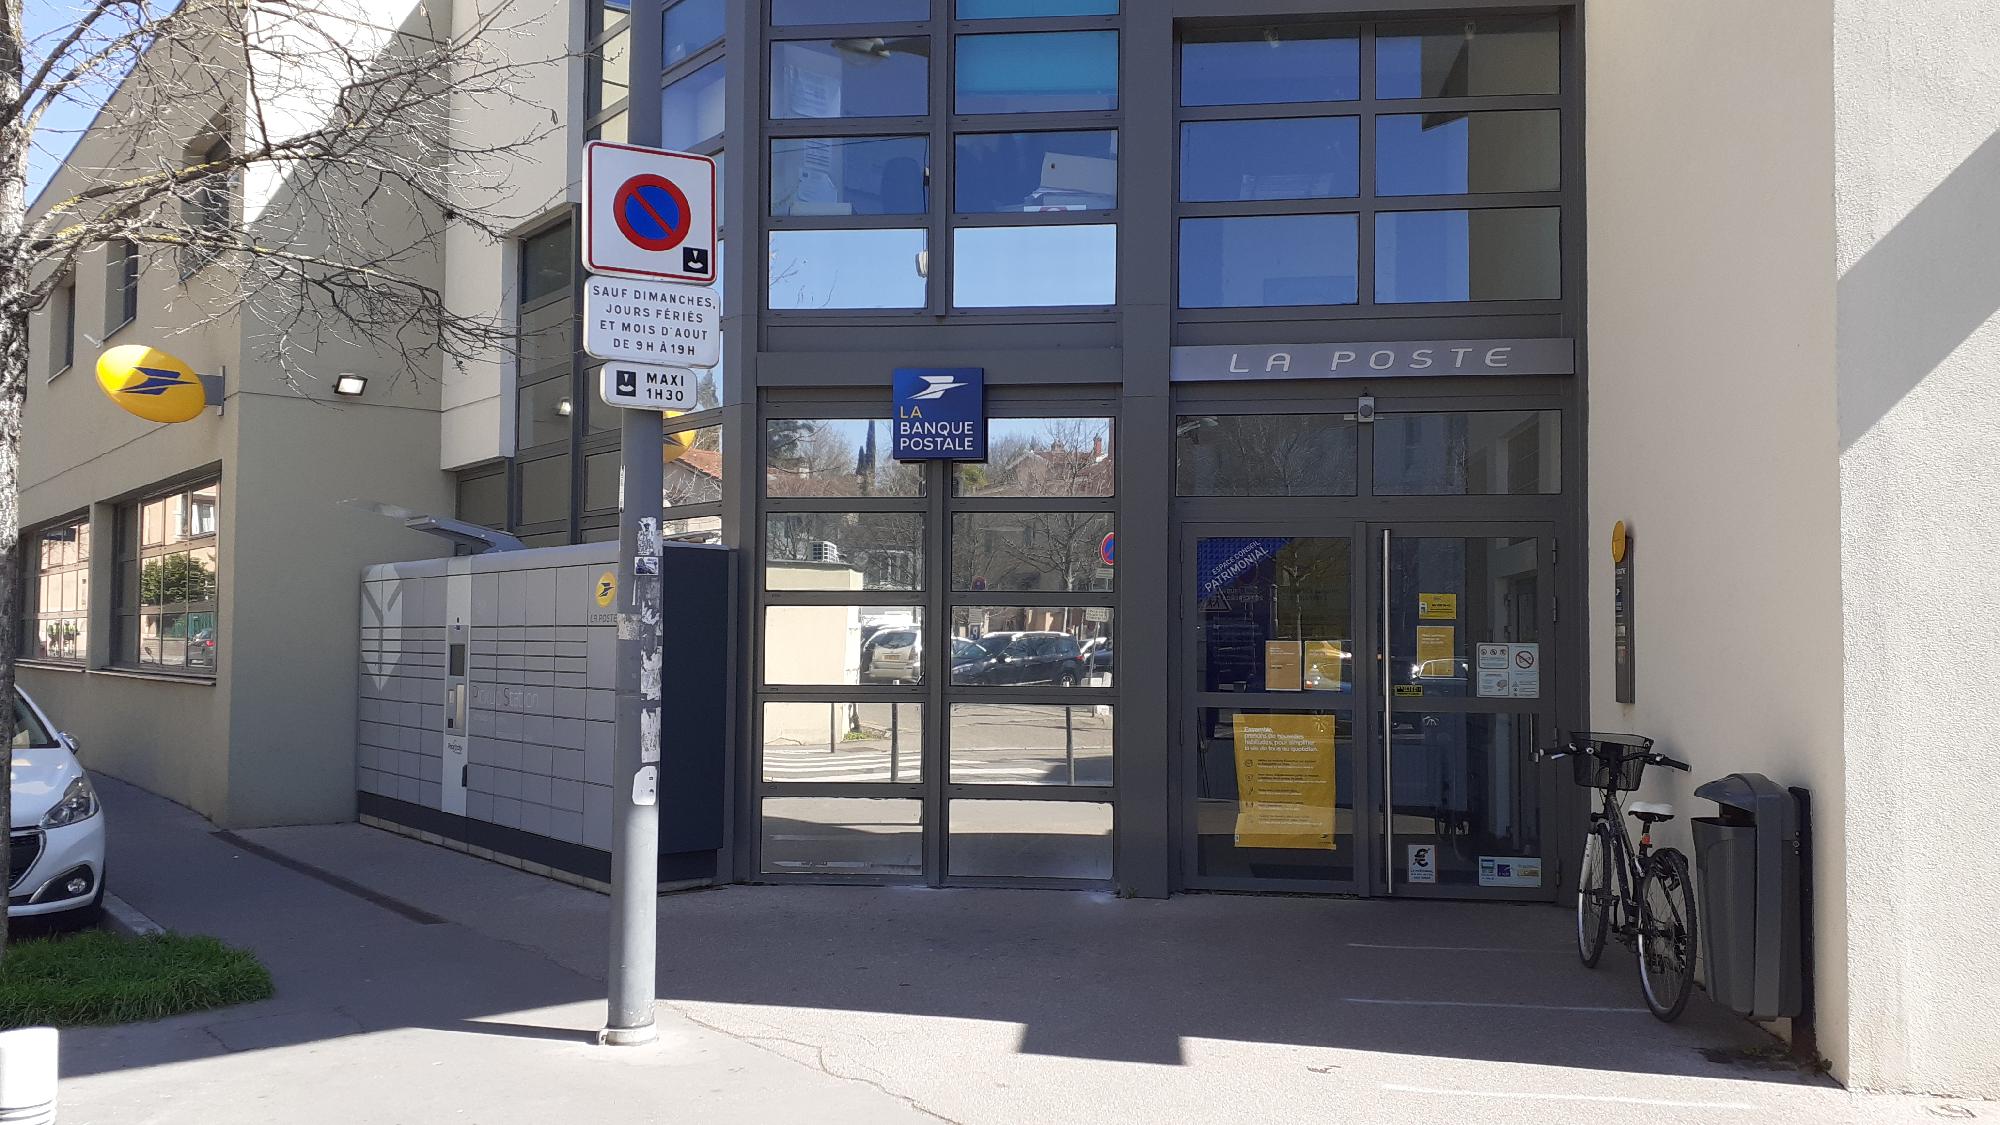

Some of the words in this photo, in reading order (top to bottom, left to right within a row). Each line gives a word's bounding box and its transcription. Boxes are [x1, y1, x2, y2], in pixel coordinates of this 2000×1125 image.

[592, 285, 628, 298] SAUF
[606, 304, 650, 318] JOURS
[656, 308, 703, 323] FÉRIÉS
[600, 320, 615, 331] ET
[621, 323, 656, 335] MOIS
[613, 338, 630, 350] DE
[636, 340, 654, 352] 9H
[1228, 352, 1291, 374] LA
[1330, 347, 1512, 371] POSTE
[646, 372, 684, 387] MAXI
[646, 388, 684, 402] 1H30
[900, 405, 922, 419] LA
[900, 421, 974, 436] BANQUE
[900, 437, 974, 451] POSTALE
[1234, 541, 1262, 560] CONSEIL
[1204, 546, 1269, 593] PATRIMONIAL
